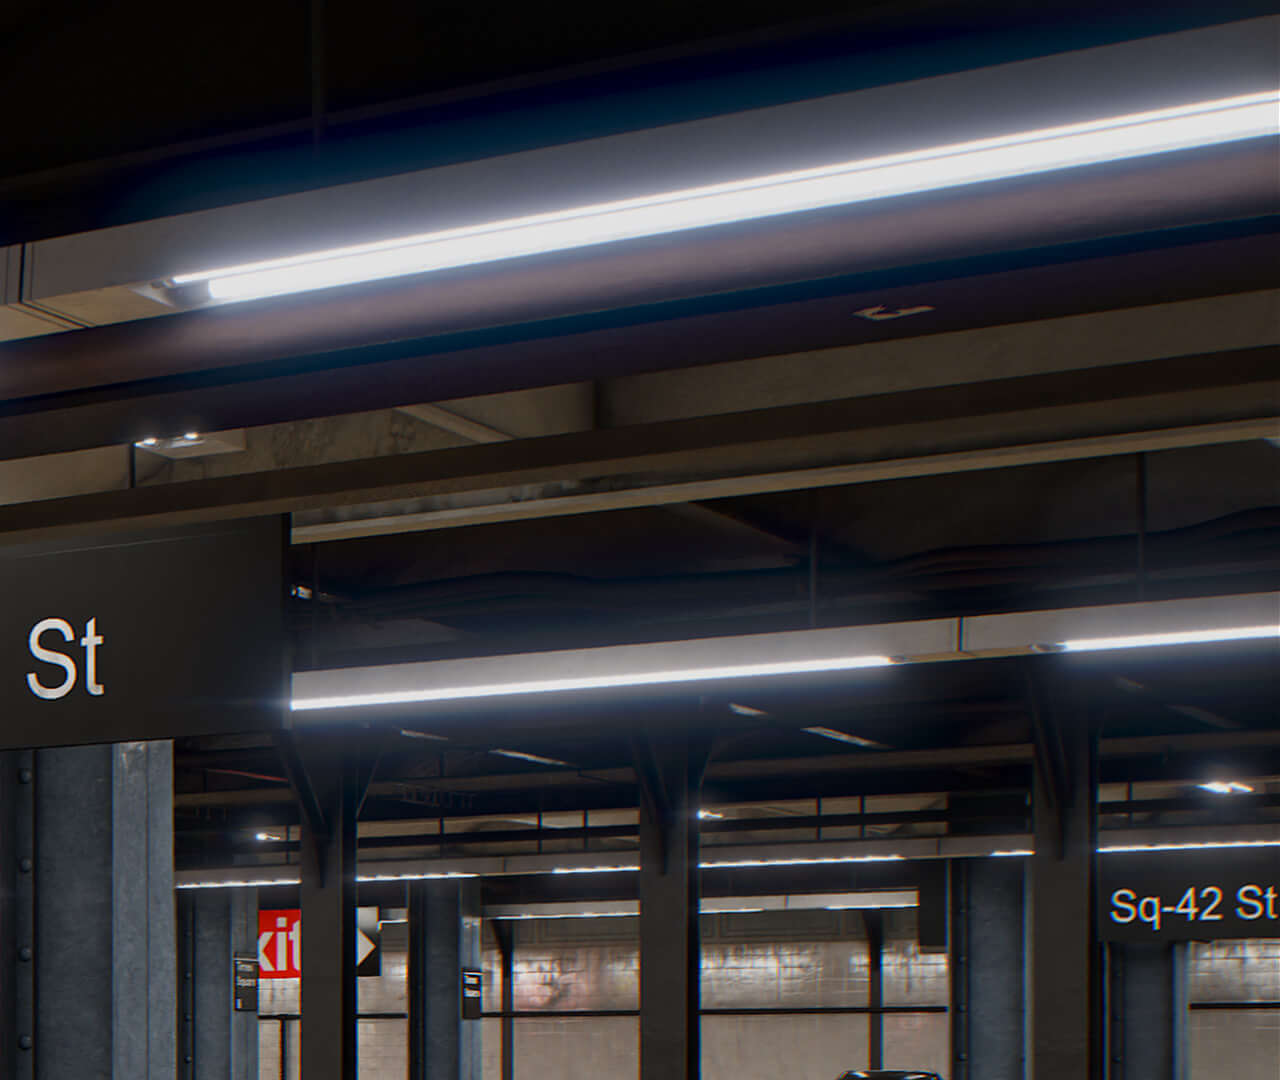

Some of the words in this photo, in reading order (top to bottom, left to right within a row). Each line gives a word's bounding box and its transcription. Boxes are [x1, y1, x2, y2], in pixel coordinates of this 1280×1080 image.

[26, 617, 104, 700] St
[1110, 887, 1224, 930] Sq-42
[1235, 884, 1279, 920] St
